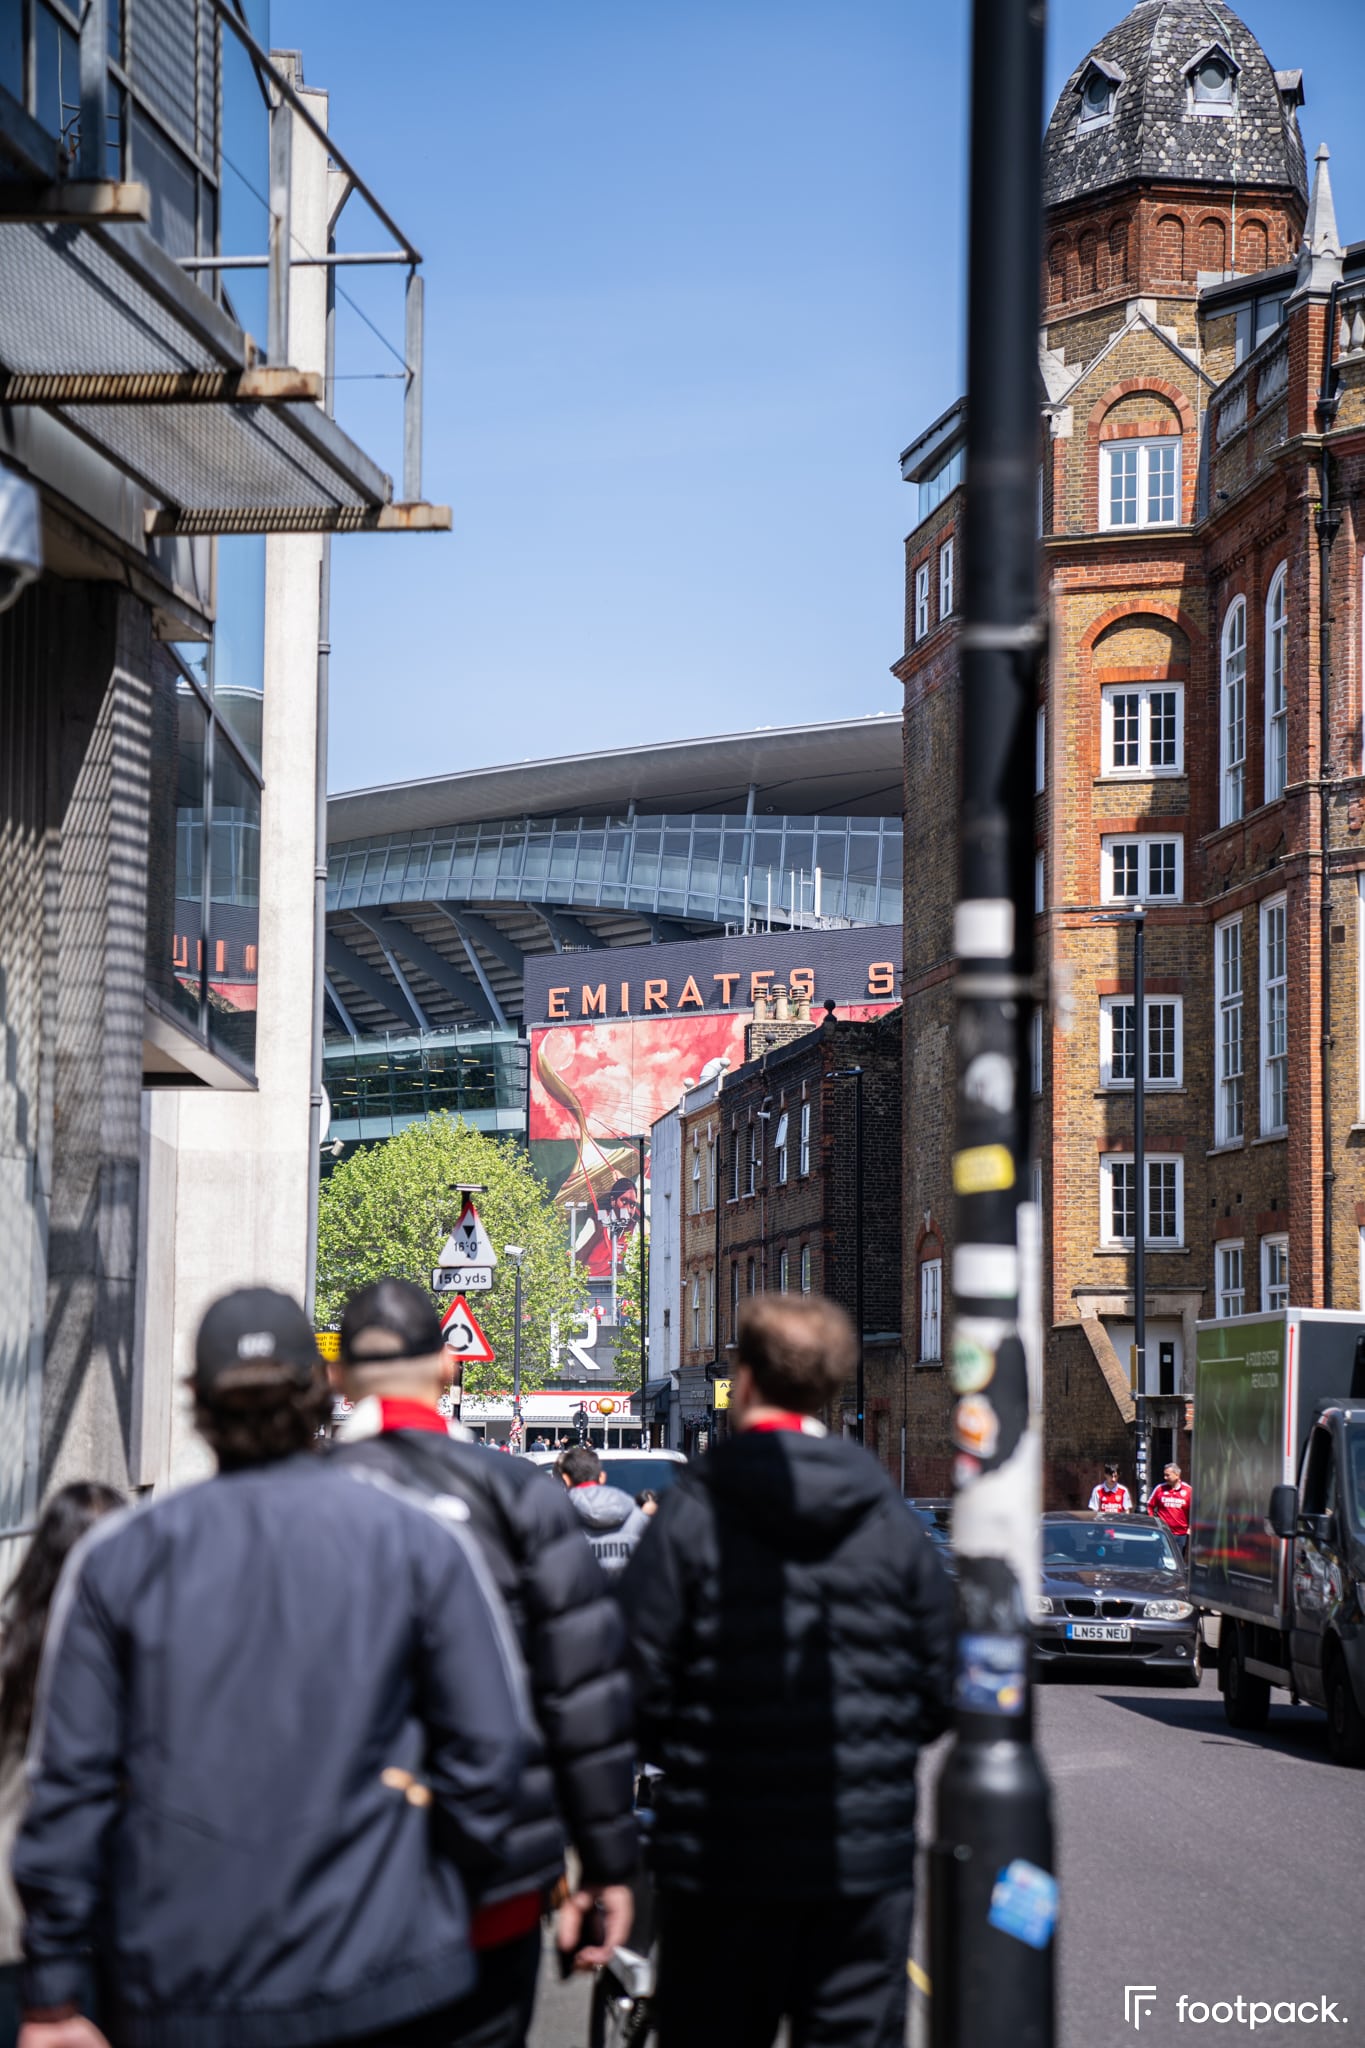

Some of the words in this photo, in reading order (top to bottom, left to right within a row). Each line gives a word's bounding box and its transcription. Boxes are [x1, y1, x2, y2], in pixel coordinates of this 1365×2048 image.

[548, 967, 814, 1018] EMIRATES
[438, 1273, 462, 1285] 150
[465, 1273, 487, 1285] yds
[1074, 1626, 1103, 1638] LN55
[1106, 1627, 1128, 1640] NEU
